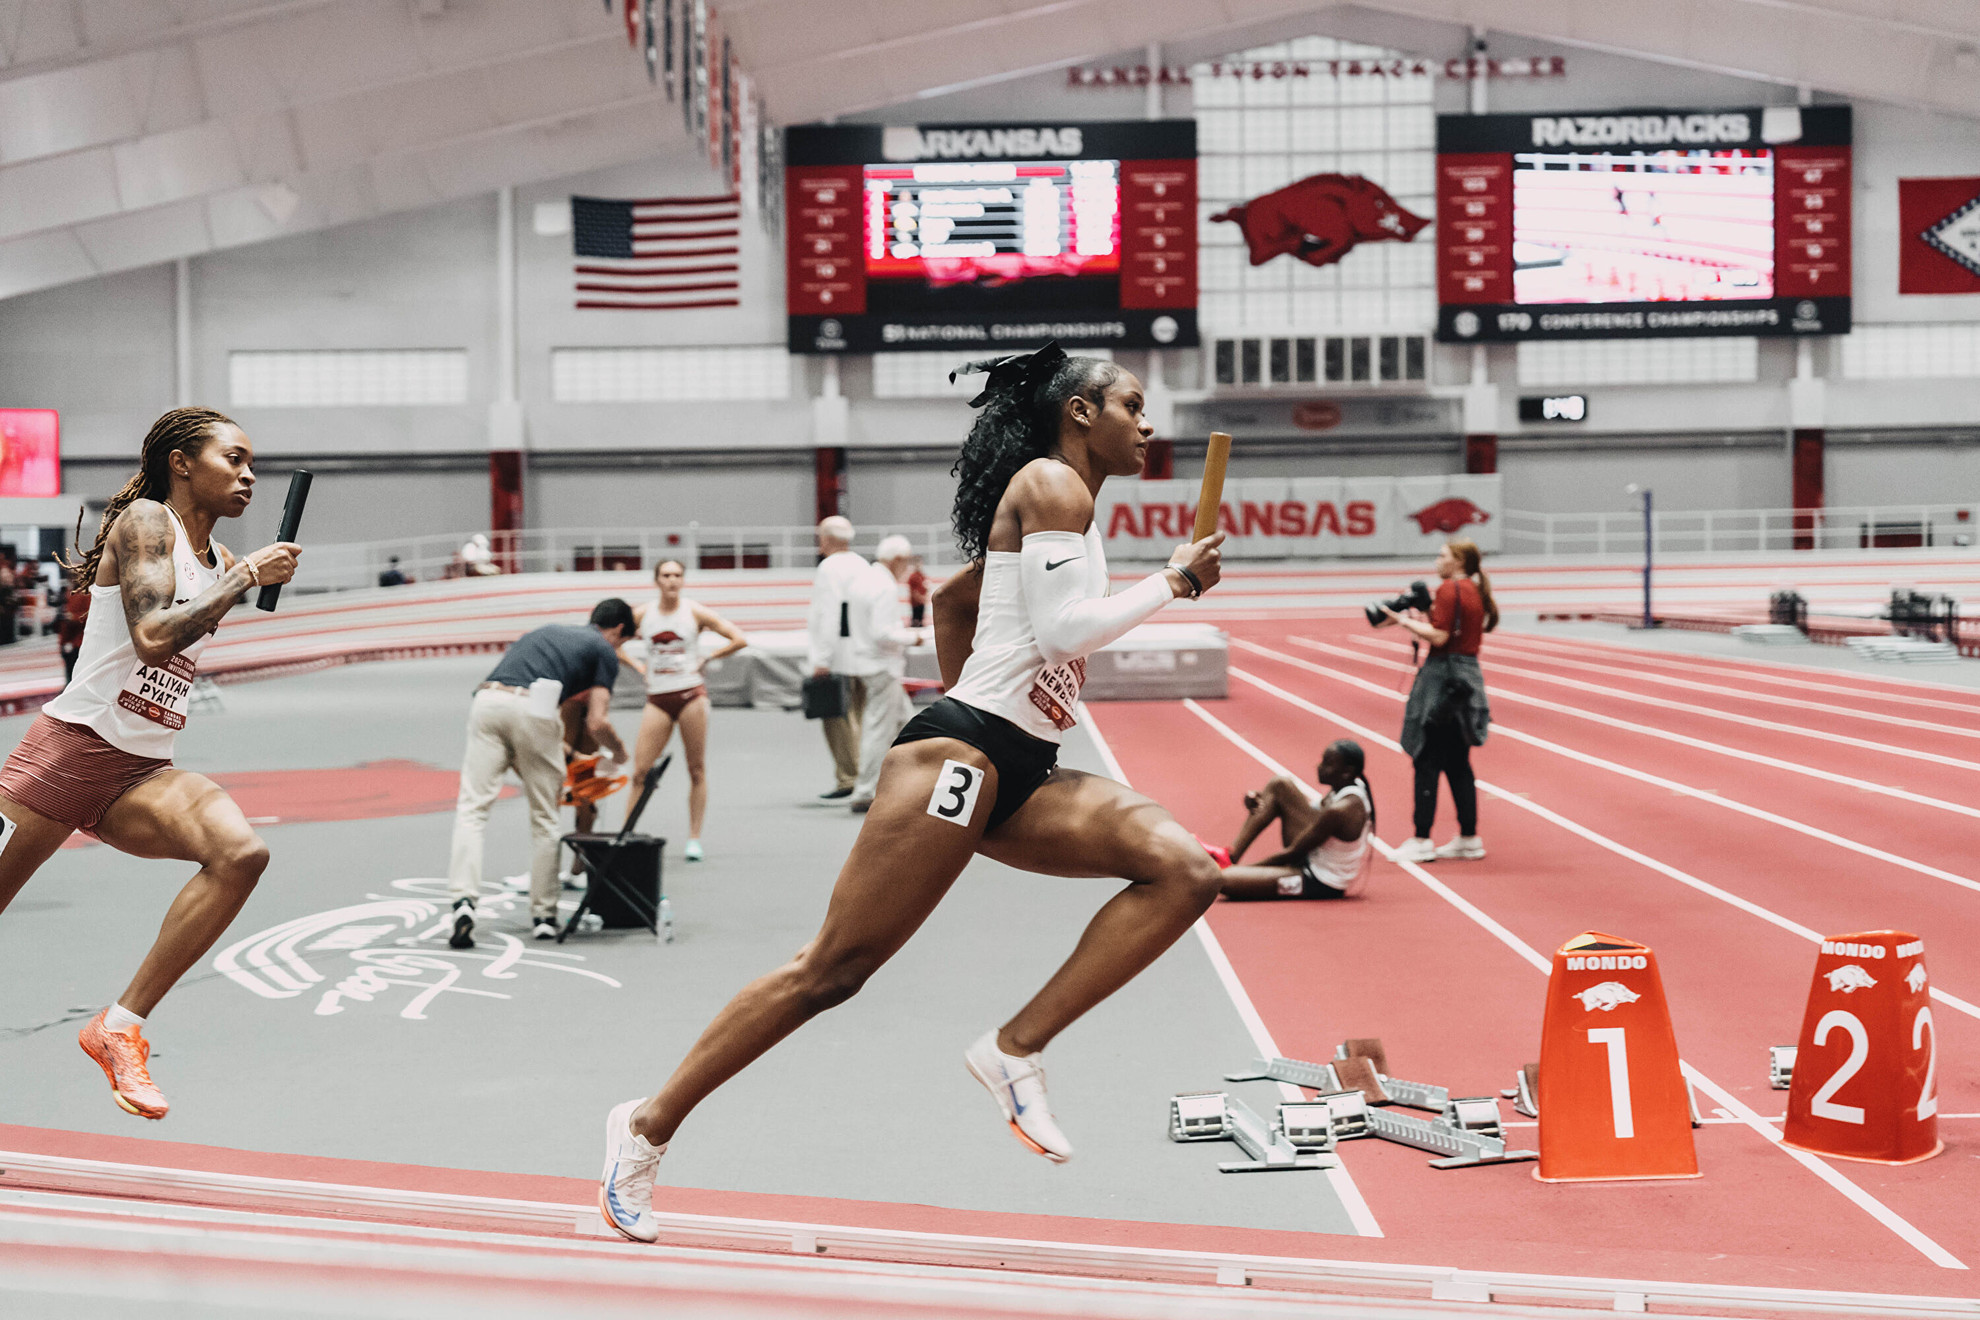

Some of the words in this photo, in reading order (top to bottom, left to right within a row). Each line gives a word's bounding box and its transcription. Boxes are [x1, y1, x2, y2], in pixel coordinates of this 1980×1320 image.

[1530, 114, 1751, 147] RAZORBACKS
[989, 320, 1126, 340] CHAMPIONSHIPS
[1539, 311, 1645, 331] CONFERENCE
[1646, 307, 1779, 328] CHAMPIONSHIPS
[1107, 500, 1377, 540] ARKANSAS
[136, 665, 190, 697] AALIYAH
[139, 682, 178, 709] PYATT
[937, 766, 973, 818] 3
[1567, 955, 1648, 971] MONDO
[1821, 941, 1886, 959] MONDO
[1811, 1009, 1869, 1125] 2
[1912, 1006, 1938, 1122] 2
[1587, 1027, 1635, 1139] 1
